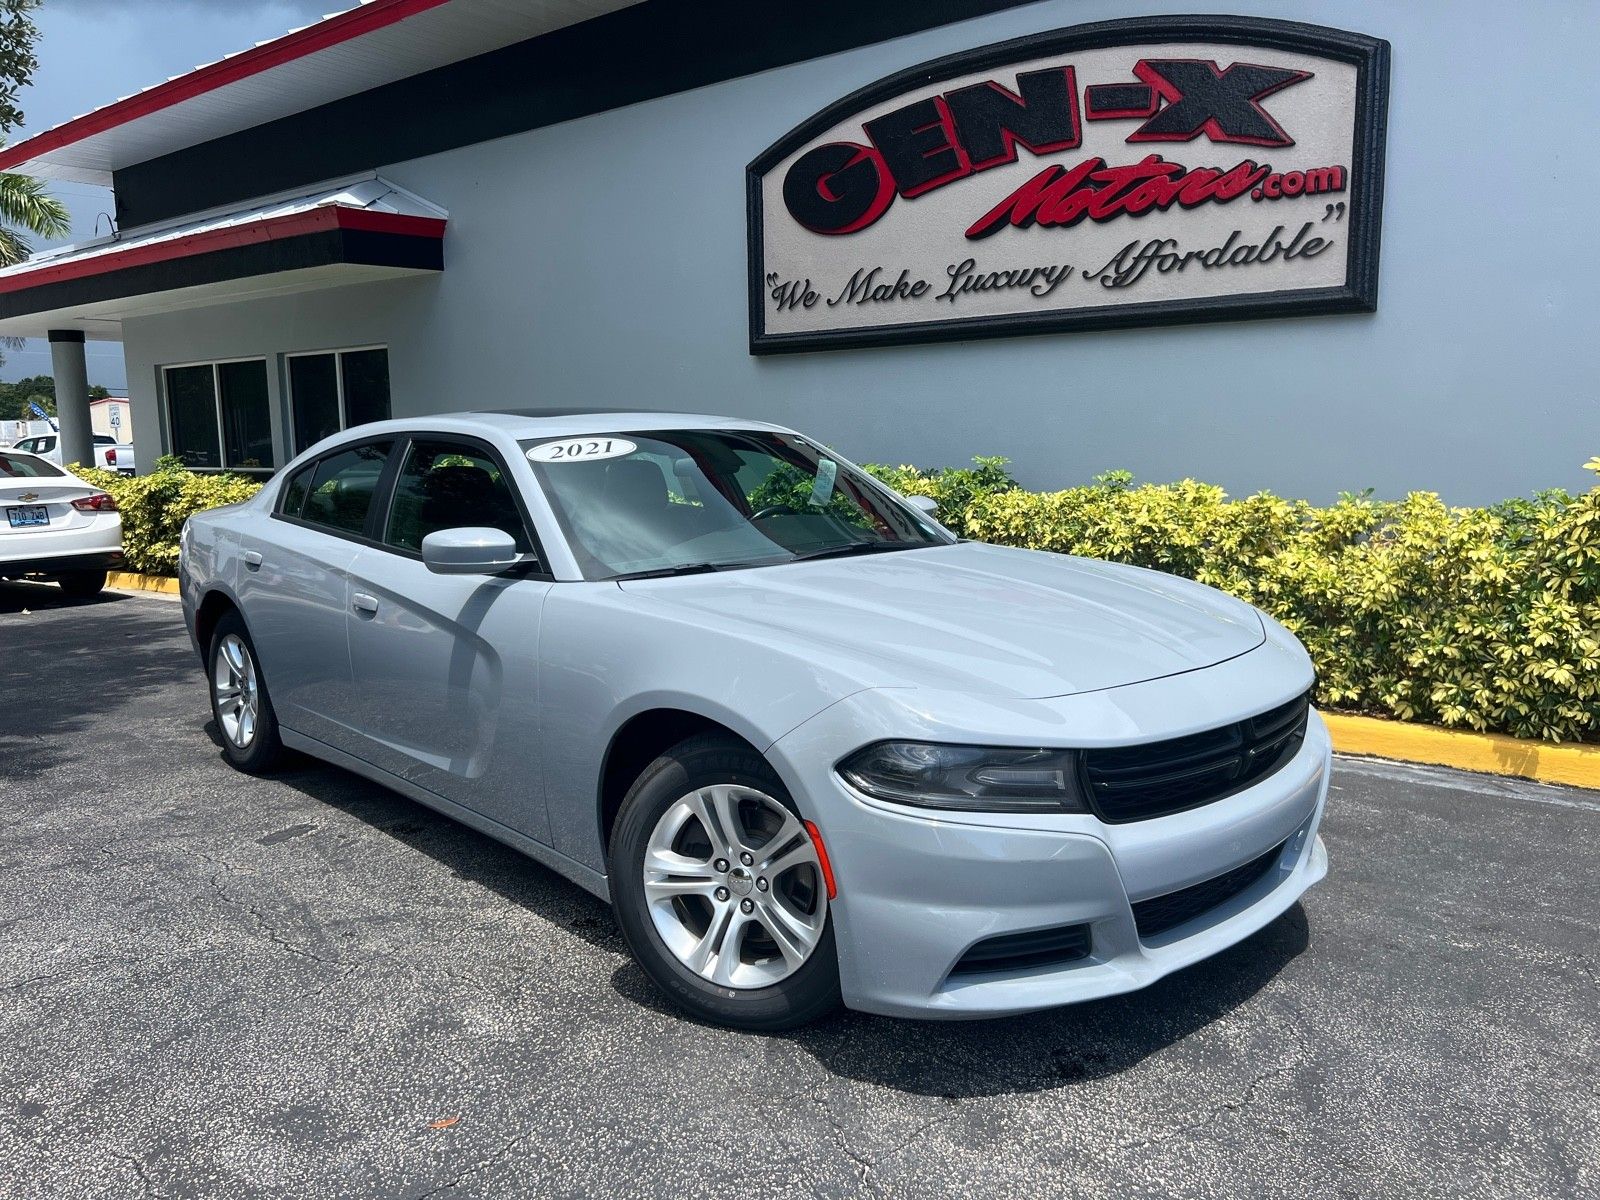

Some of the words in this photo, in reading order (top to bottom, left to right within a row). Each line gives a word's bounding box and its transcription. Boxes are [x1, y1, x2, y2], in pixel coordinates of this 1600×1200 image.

[782, 58, 1315, 236] GEN-X
[827, 266, 932, 307] Make
[934, 258, 1074, 304] Luxury
[111, 417, 120, 426] 40
[549, 440, 613, 460] 2021
